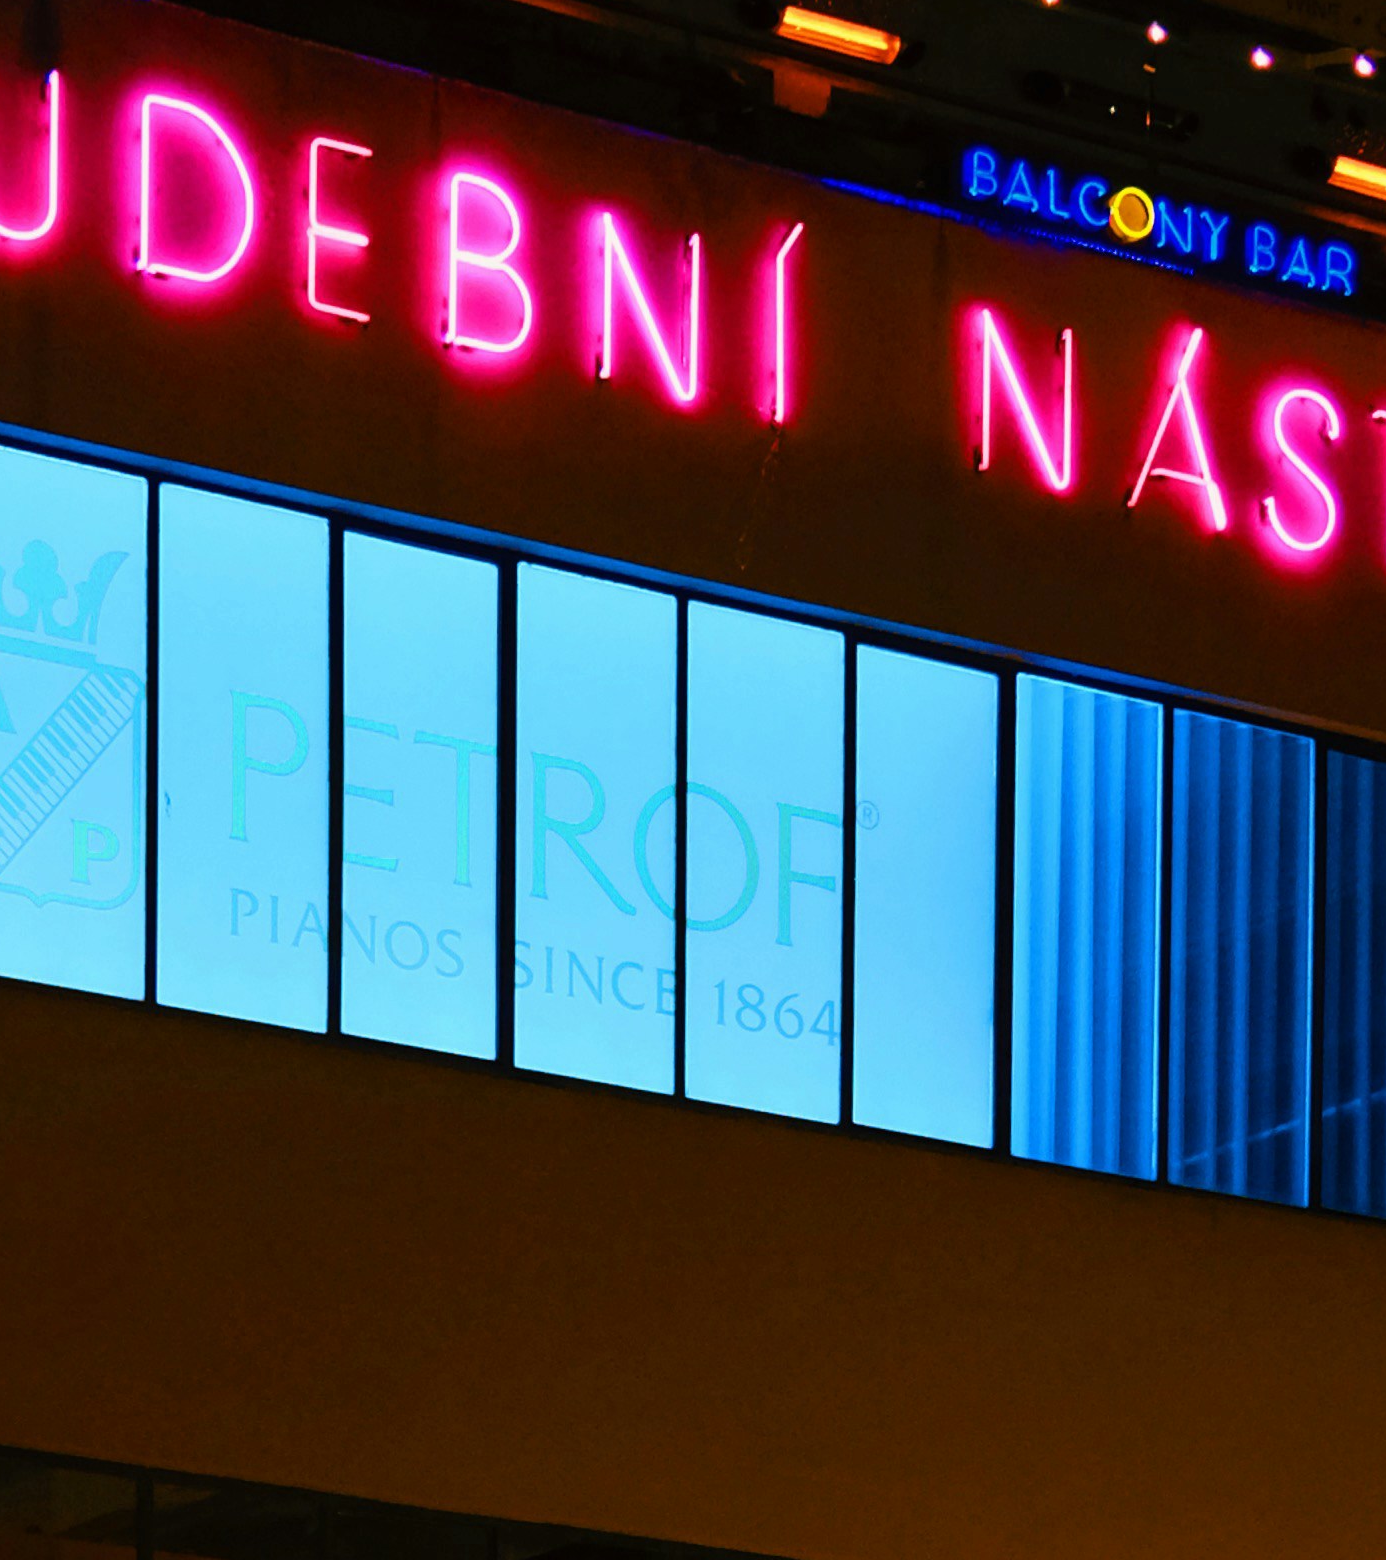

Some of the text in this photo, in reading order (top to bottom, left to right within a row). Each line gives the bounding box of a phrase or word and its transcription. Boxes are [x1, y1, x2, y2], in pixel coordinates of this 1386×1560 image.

[965, 146, 1358, 297] BALCONY BAR
[228, 688, 843, 948] PETROF
[229, 888, 842, 1048] PIANOS SINCE 1864
